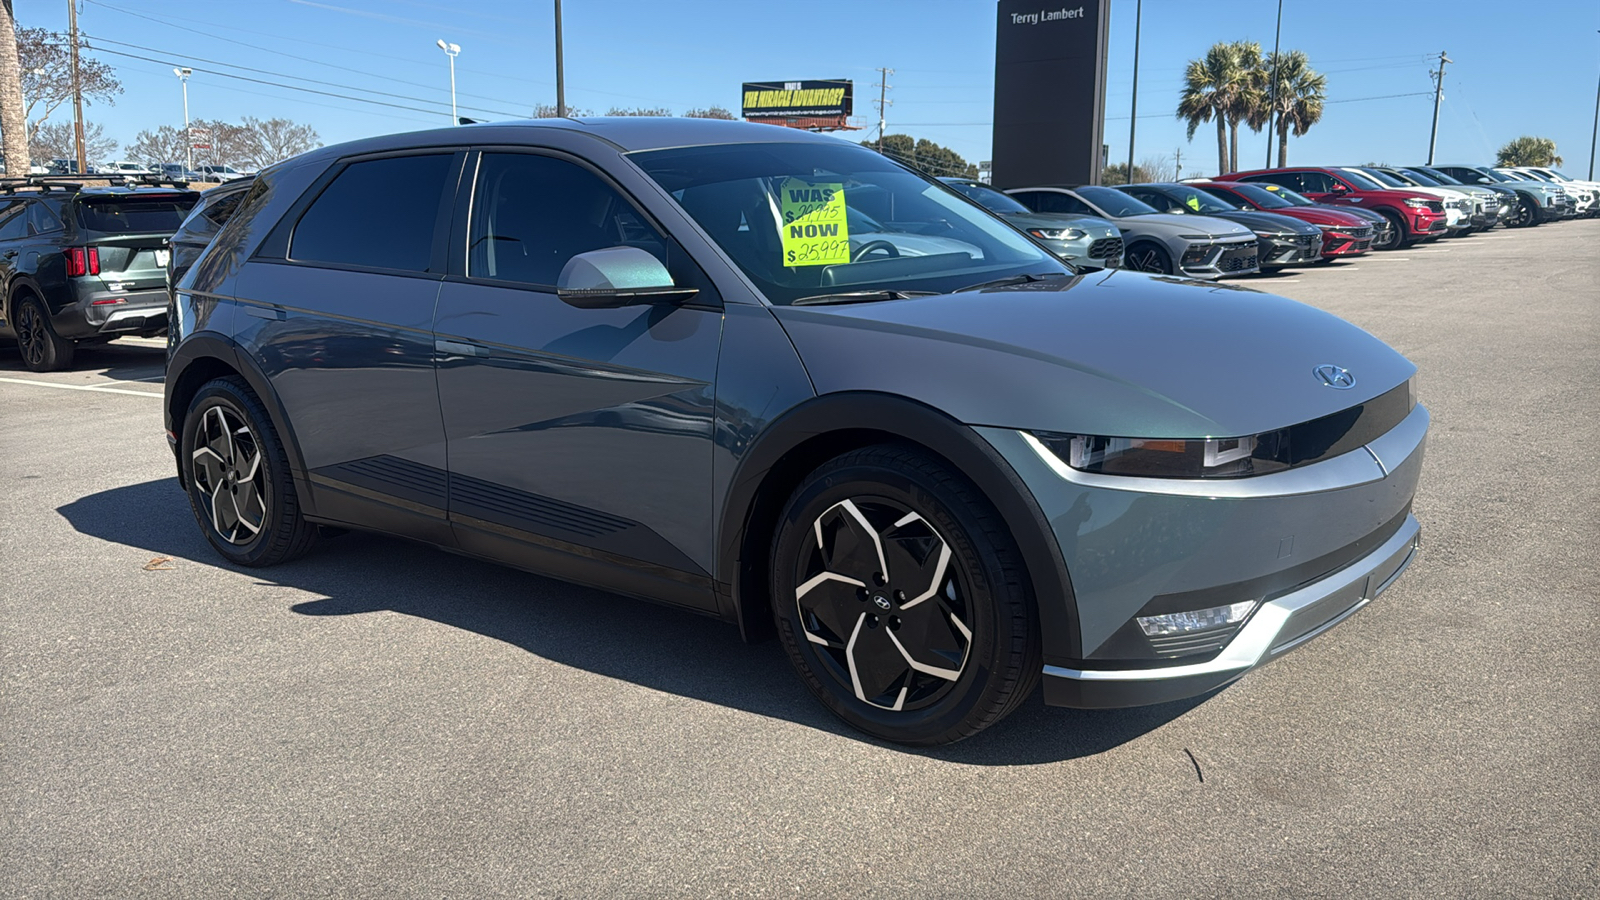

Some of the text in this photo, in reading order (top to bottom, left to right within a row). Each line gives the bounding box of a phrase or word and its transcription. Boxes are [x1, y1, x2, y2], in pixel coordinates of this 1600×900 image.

[1011, 6, 1084, 25] Terry Lambert
[743, 88, 845, 108] THE MIRACLE ADVANTAGE?
[789, 189, 835, 203] WAS
[790, 224, 839, 239] NOW
